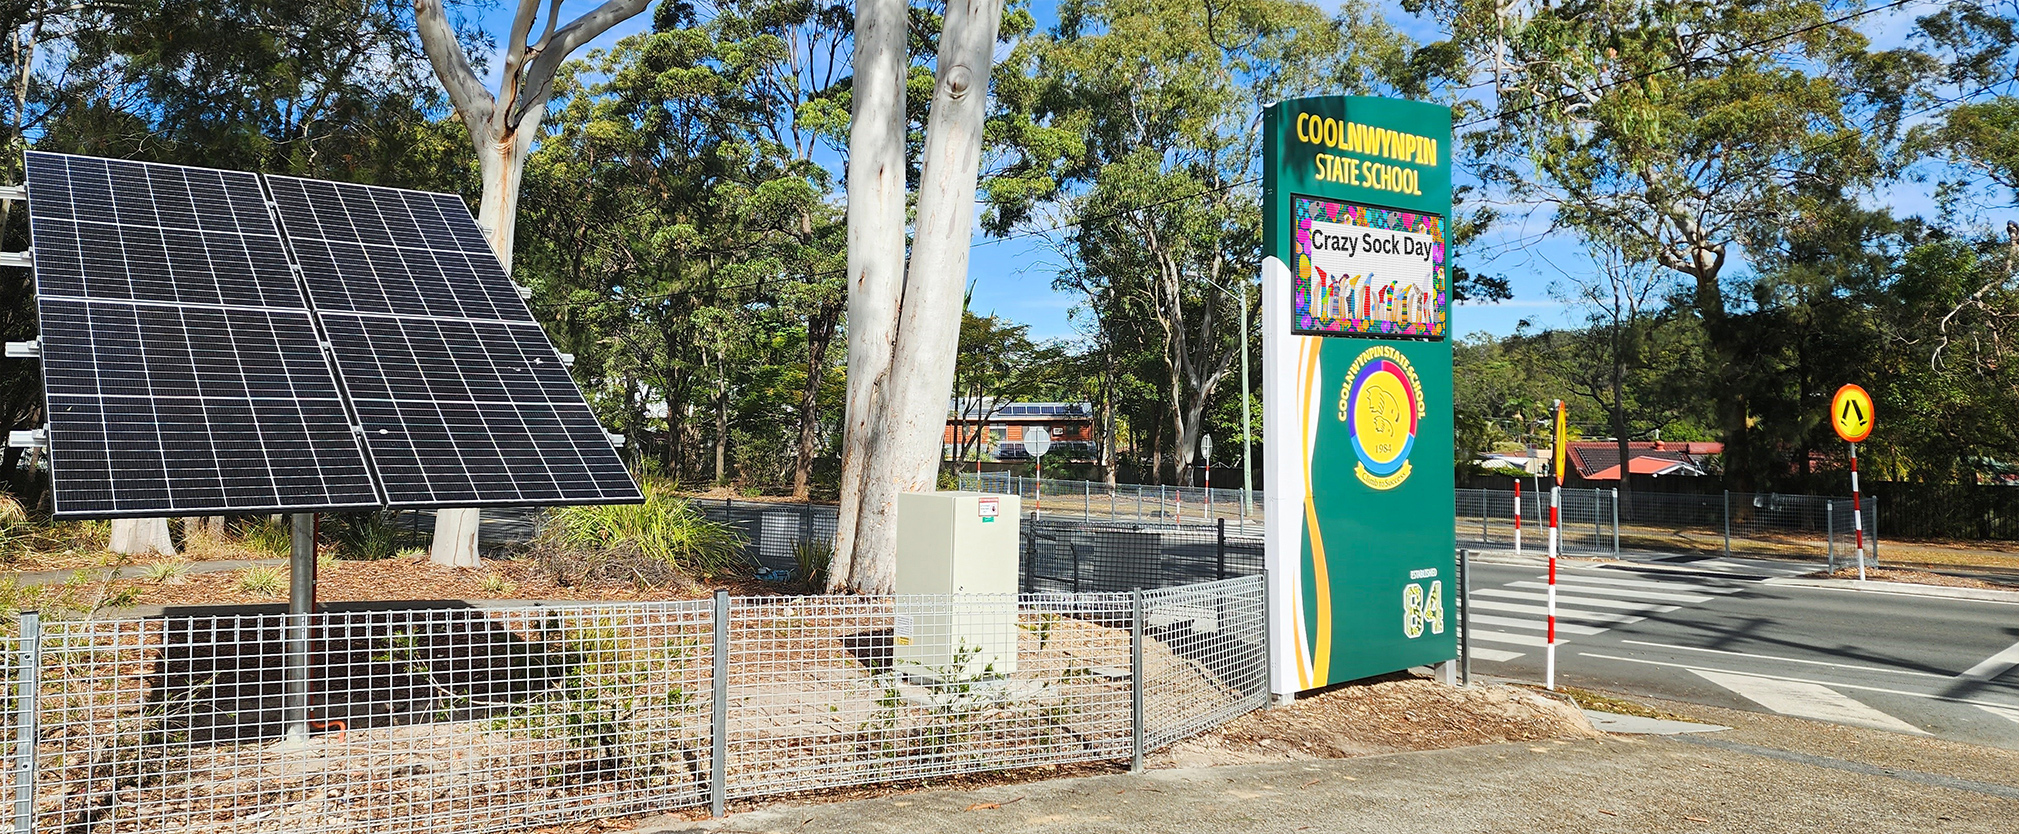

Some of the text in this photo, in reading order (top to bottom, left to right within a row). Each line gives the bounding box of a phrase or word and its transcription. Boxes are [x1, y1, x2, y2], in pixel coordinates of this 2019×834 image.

[1297, 112, 1437, 166] COOLNWYNPIN
[1315, 153, 1421, 195] STATE SCHOOL
[1312, 229, 1432, 261] Crazy Sock Day
[1338, 345, 1426, 421] COOLNWYNPIN STATE SCHOOL
[1375, 443, 1392, 454] 1984
[1403, 580, 1444, 638] 84
